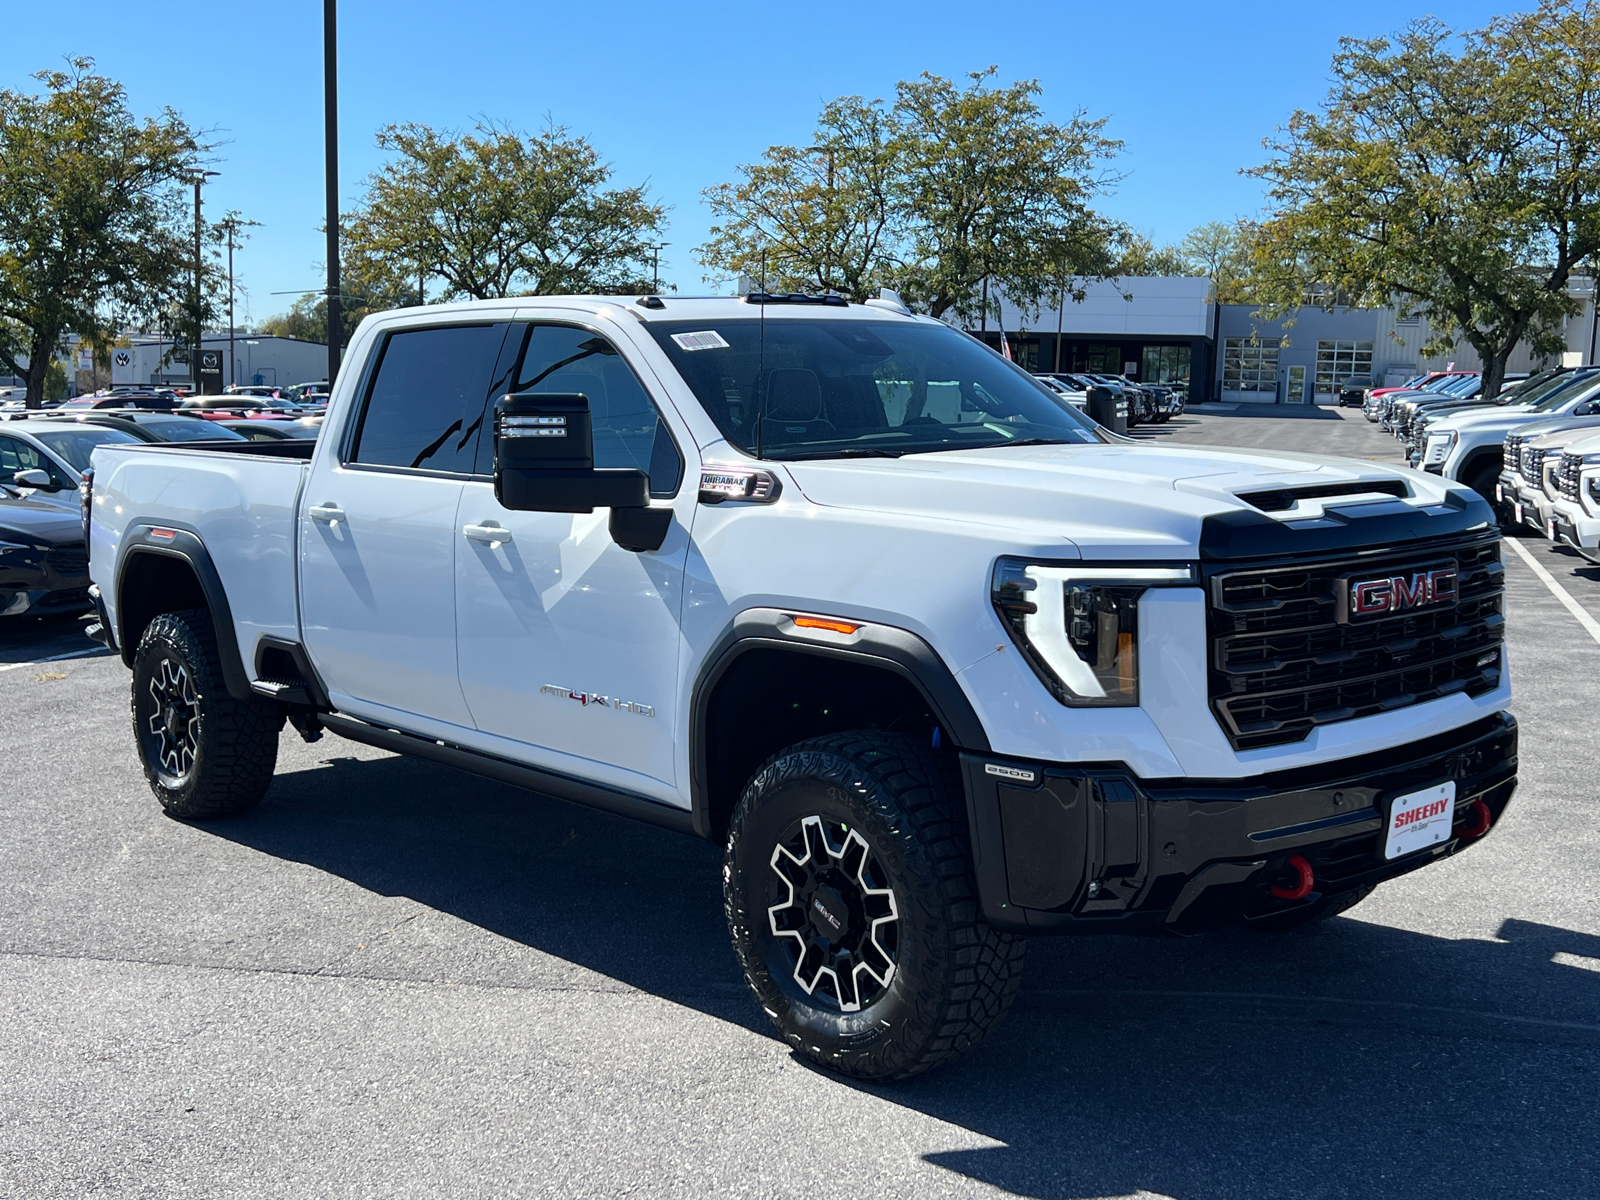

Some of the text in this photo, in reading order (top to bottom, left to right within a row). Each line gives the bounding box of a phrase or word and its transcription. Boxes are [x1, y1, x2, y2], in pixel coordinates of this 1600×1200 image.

[704, 475, 745, 486] DURAMAX
[1351, 568, 1457, 615] GMC
[540, 683, 655, 718] AT4X HD
[987, 766, 1032, 778] 2500
[1394, 797, 1449, 829] SHEEHY
[814, 898, 841, 930] GMC
